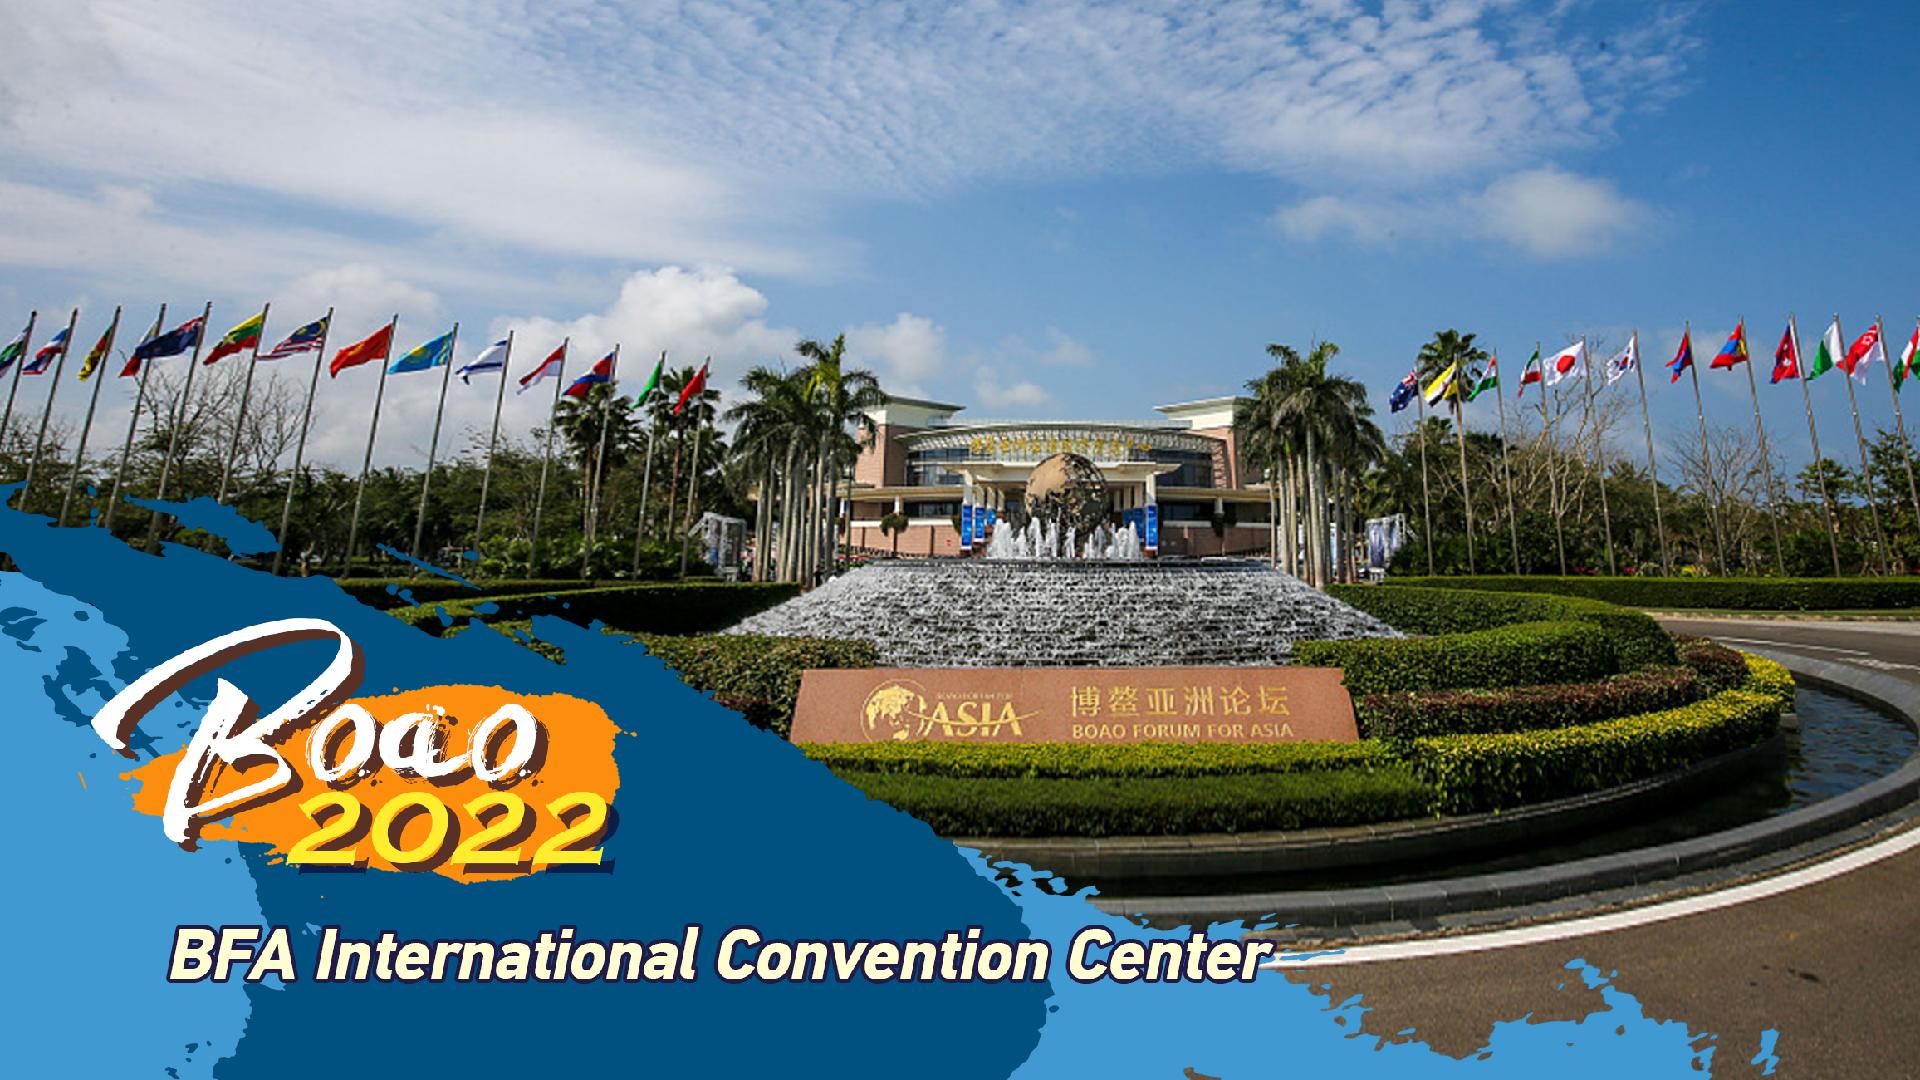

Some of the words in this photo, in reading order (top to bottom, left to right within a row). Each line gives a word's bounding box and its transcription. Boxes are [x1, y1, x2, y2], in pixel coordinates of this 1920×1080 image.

[1070, 685, 1290, 718] 博鳌亚洲论坛
[922, 701, 1023, 737] ASIA
[1072, 724, 1126, 739] BOAO
[1133, 724, 1201, 738] FORUM
[1207, 724, 1244, 738] FOR
[1250, 723, 1294, 738] ASIA
